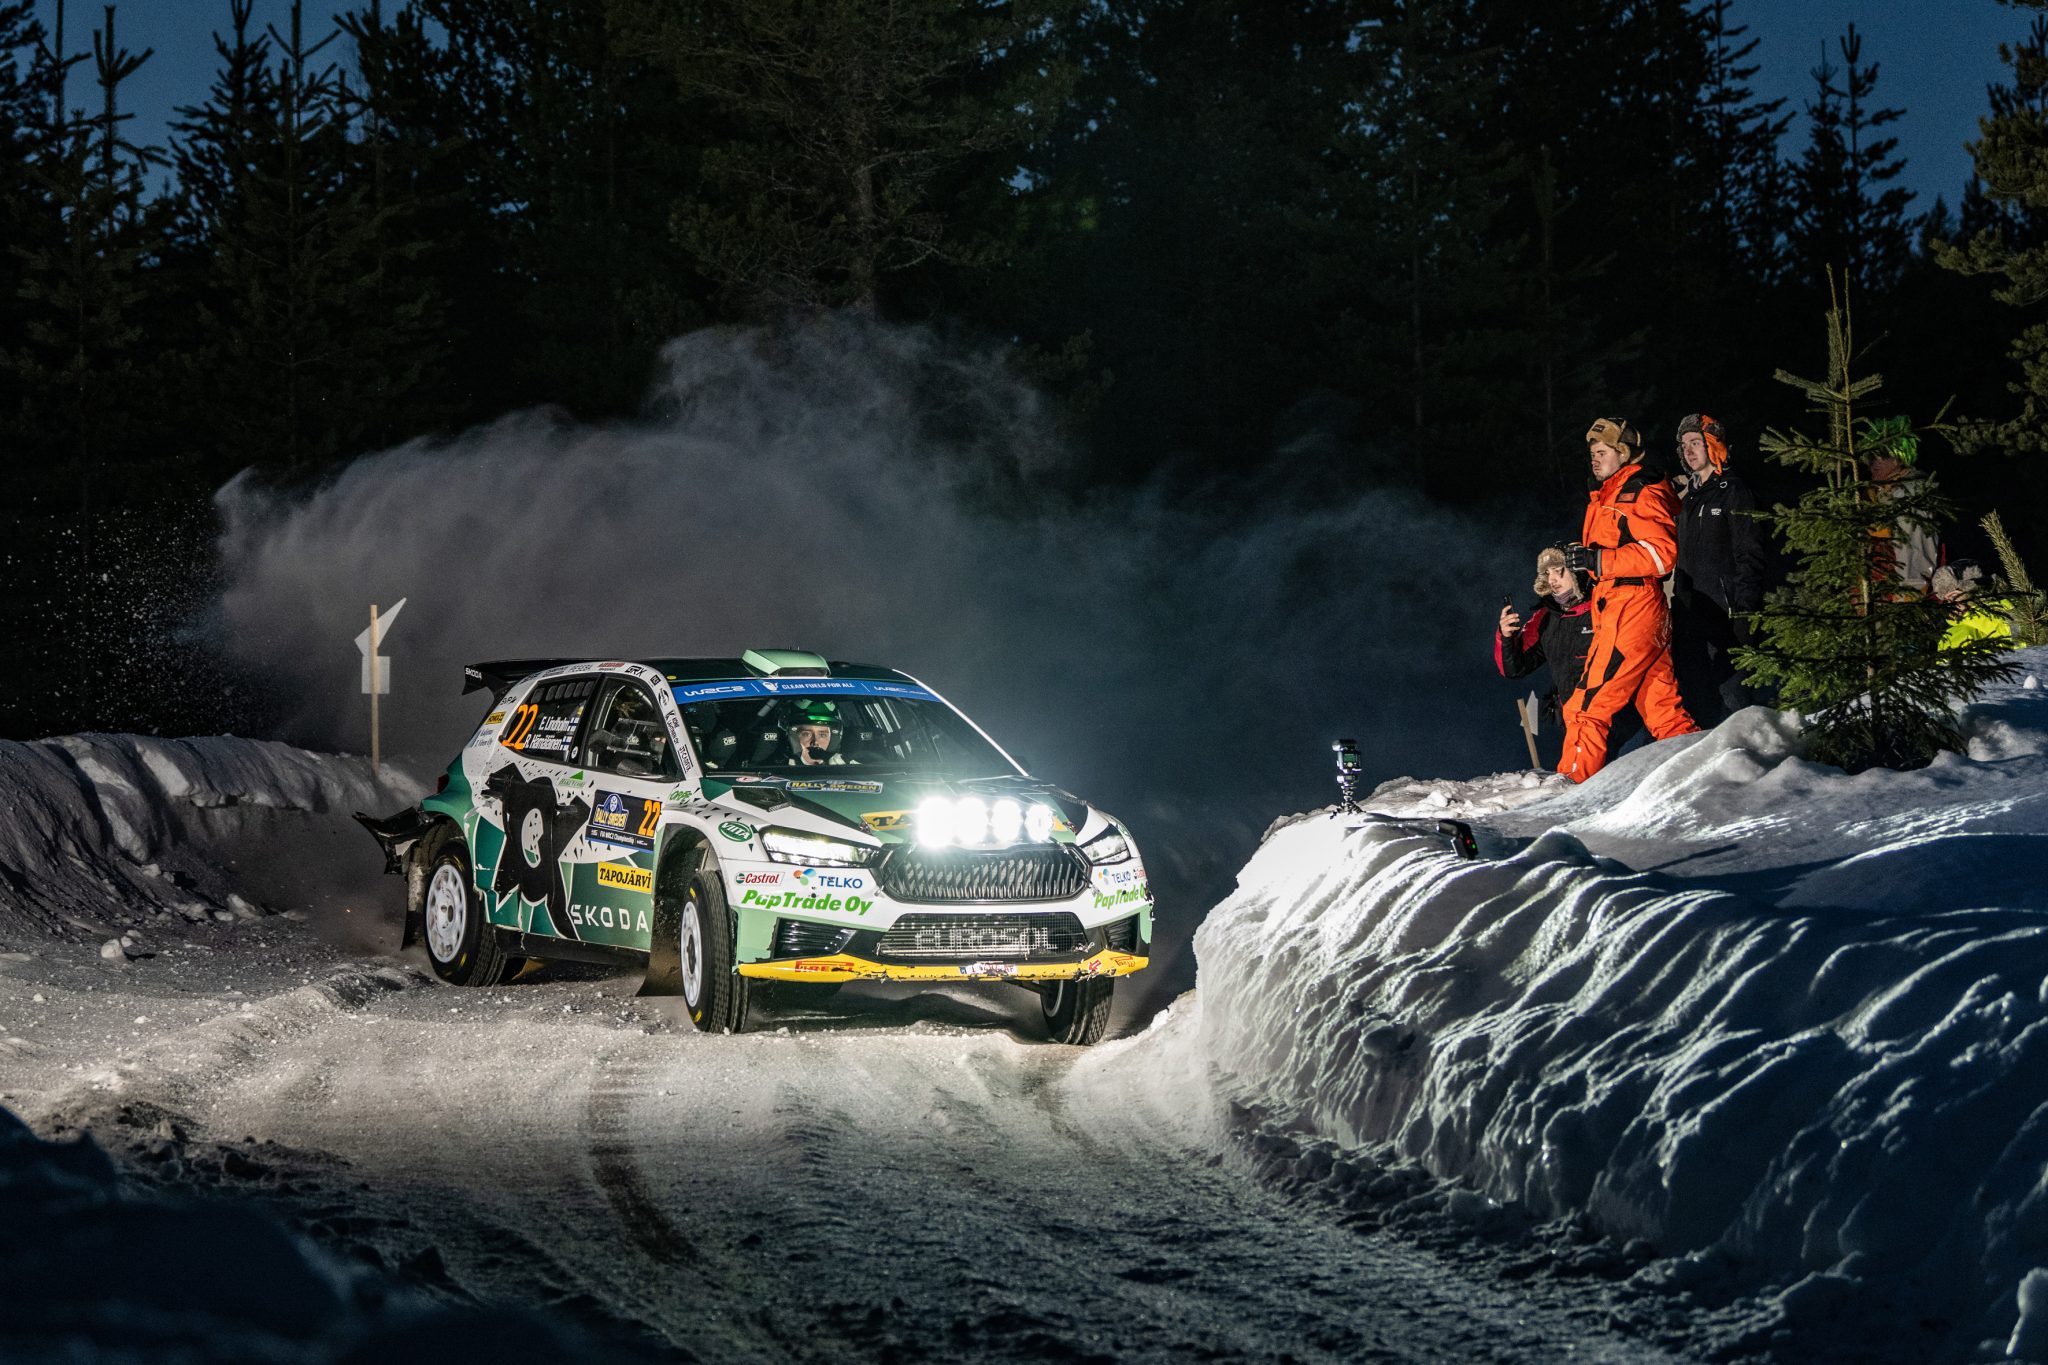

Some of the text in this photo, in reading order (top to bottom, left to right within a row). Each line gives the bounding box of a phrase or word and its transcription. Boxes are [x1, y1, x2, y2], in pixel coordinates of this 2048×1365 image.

[502, 703, 539, 750] 22
[791, 781, 826, 789] RALLY
[594, 807, 628, 828] RALLY SWEDEN
[638, 799, 661, 838] 22
[600, 867, 652, 889] TAPOJÄRVI
[745, 873, 780, 884] Castrol
[818, 876, 863, 889] TELKO
[1112, 871, 1131, 884] TELKO
[741, 890, 874, 916] PapTrade Oy
[1094, 884, 1139, 910] PapTrade
[570, 904, 650, 933] SKODA
